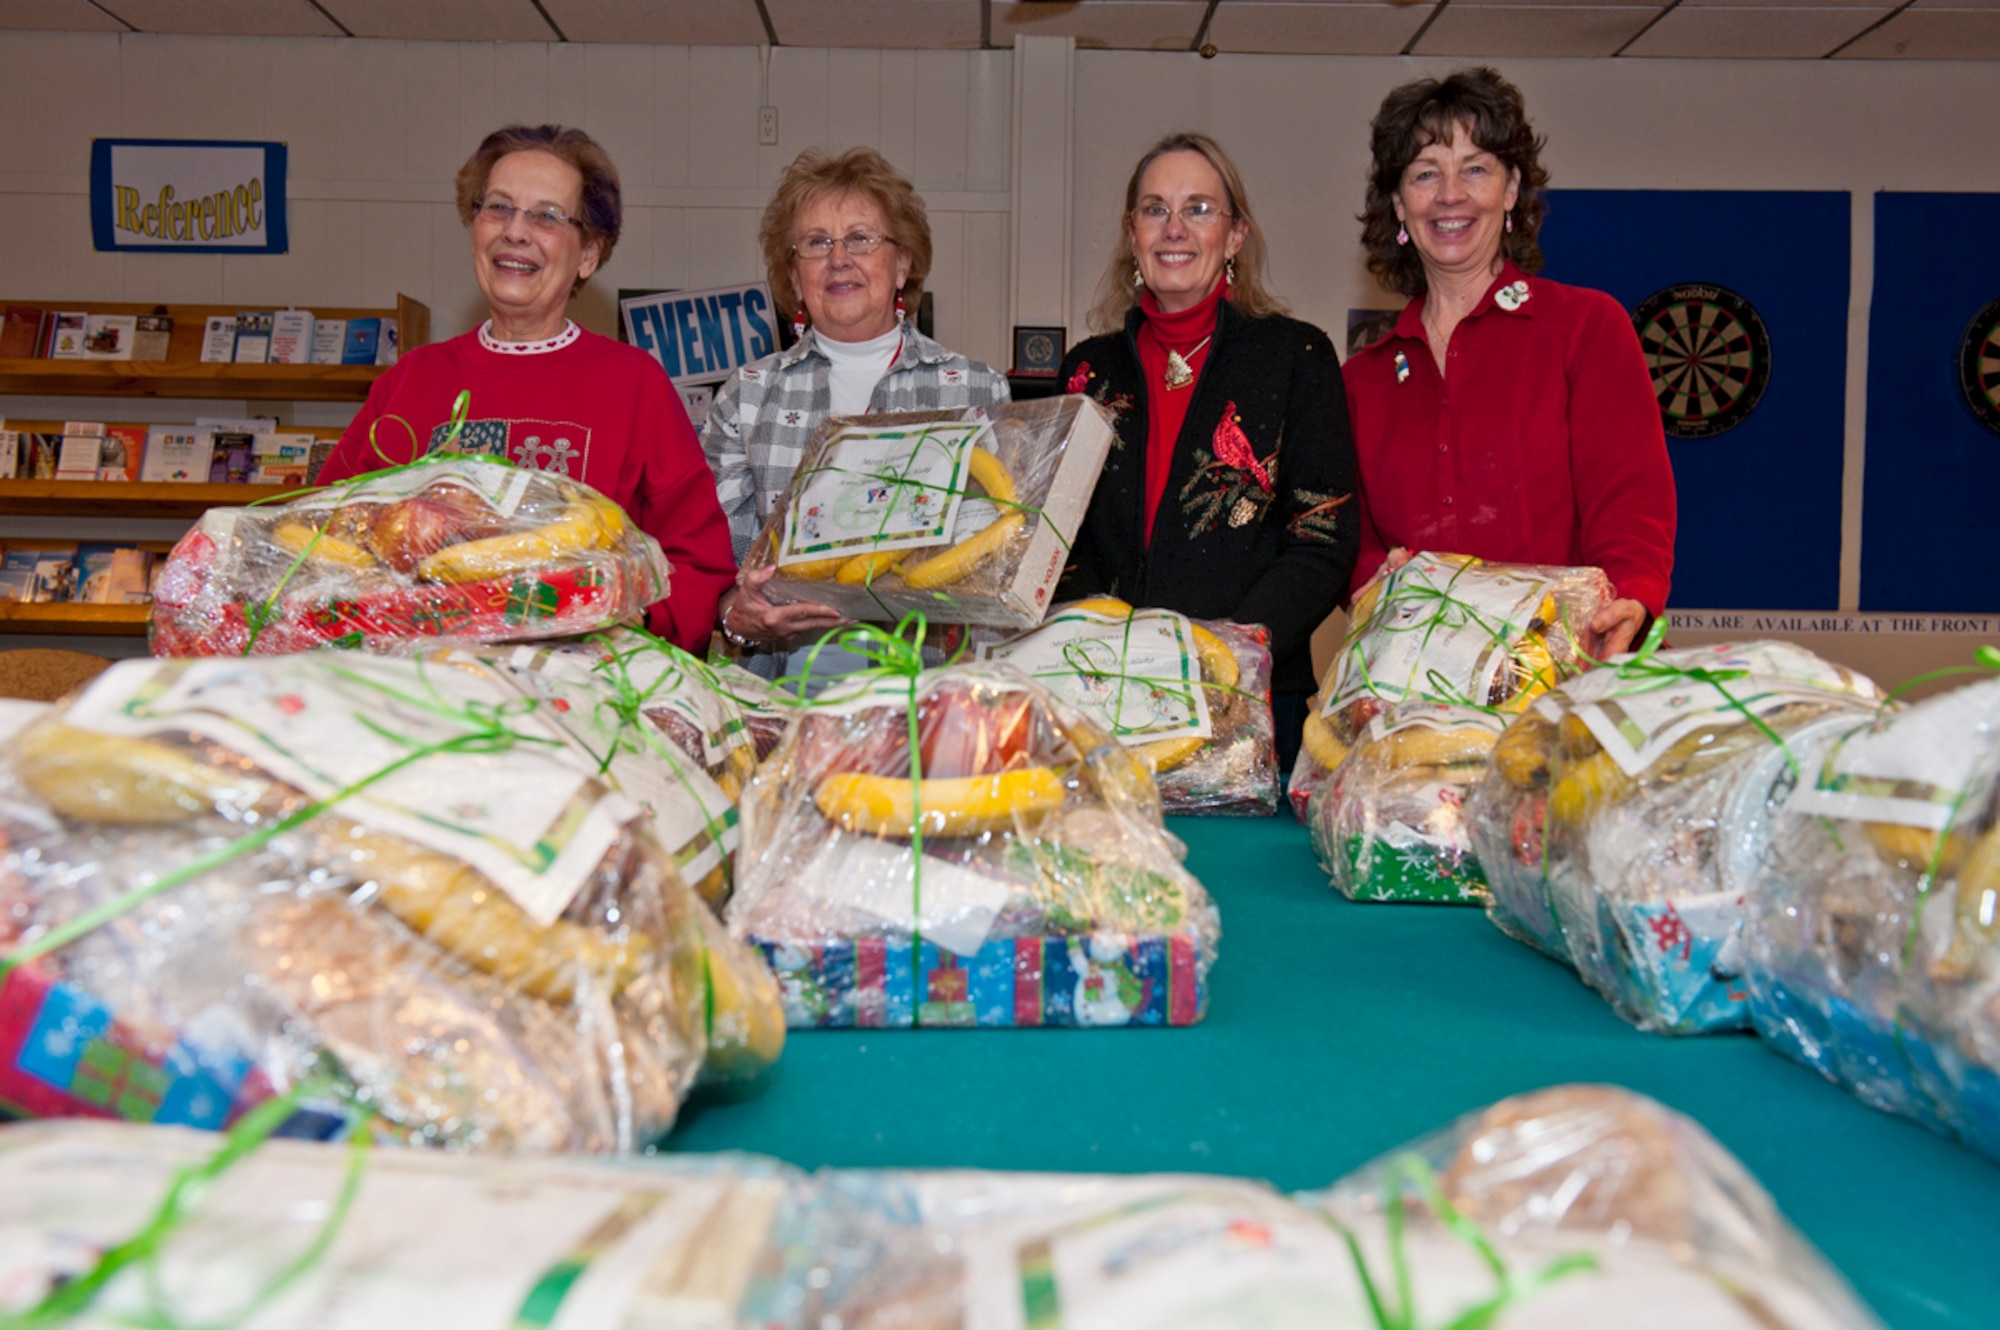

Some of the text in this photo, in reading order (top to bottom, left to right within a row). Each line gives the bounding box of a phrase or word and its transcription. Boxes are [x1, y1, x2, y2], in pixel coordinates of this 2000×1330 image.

[114, 177, 262, 241] Reference
[629, 288, 774, 377] EVENTS
[1669, 615, 1703, 628] RTS
[1708, 616, 1744, 628] ARE
[1752, 617, 1854, 632] AVAILABLE
[1859, 619, 1882, 632] AT
[1890, 618, 1926, 632] THE
[1931, 619, 1991, 632] FRONT
